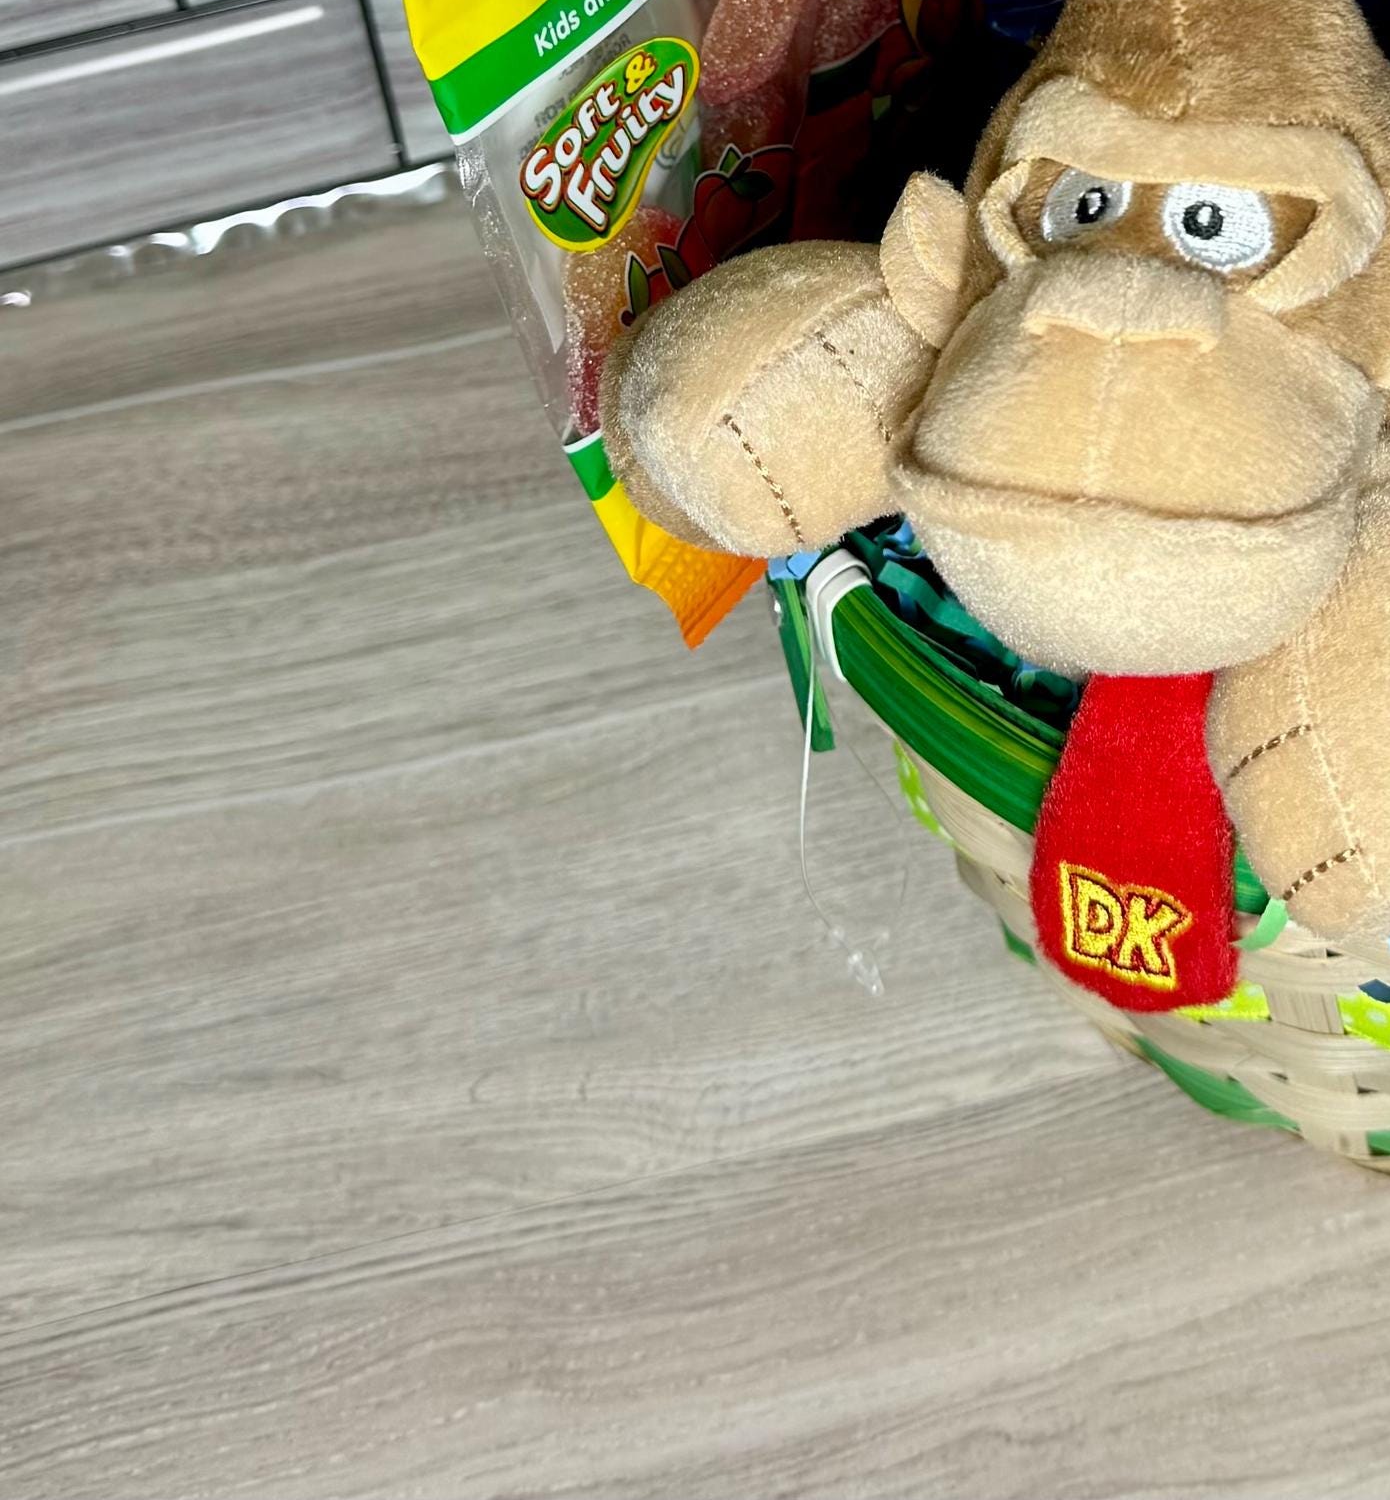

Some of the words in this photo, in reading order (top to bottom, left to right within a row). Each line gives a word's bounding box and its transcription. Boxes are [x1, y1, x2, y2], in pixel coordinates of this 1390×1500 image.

[534, 8, 581, 57] Kids
[523, 80, 621, 209] Soft
[625, 51, 658, 95] &
[566, 64, 687, 229] Fruity
[1059, 861, 1193, 990] DK
